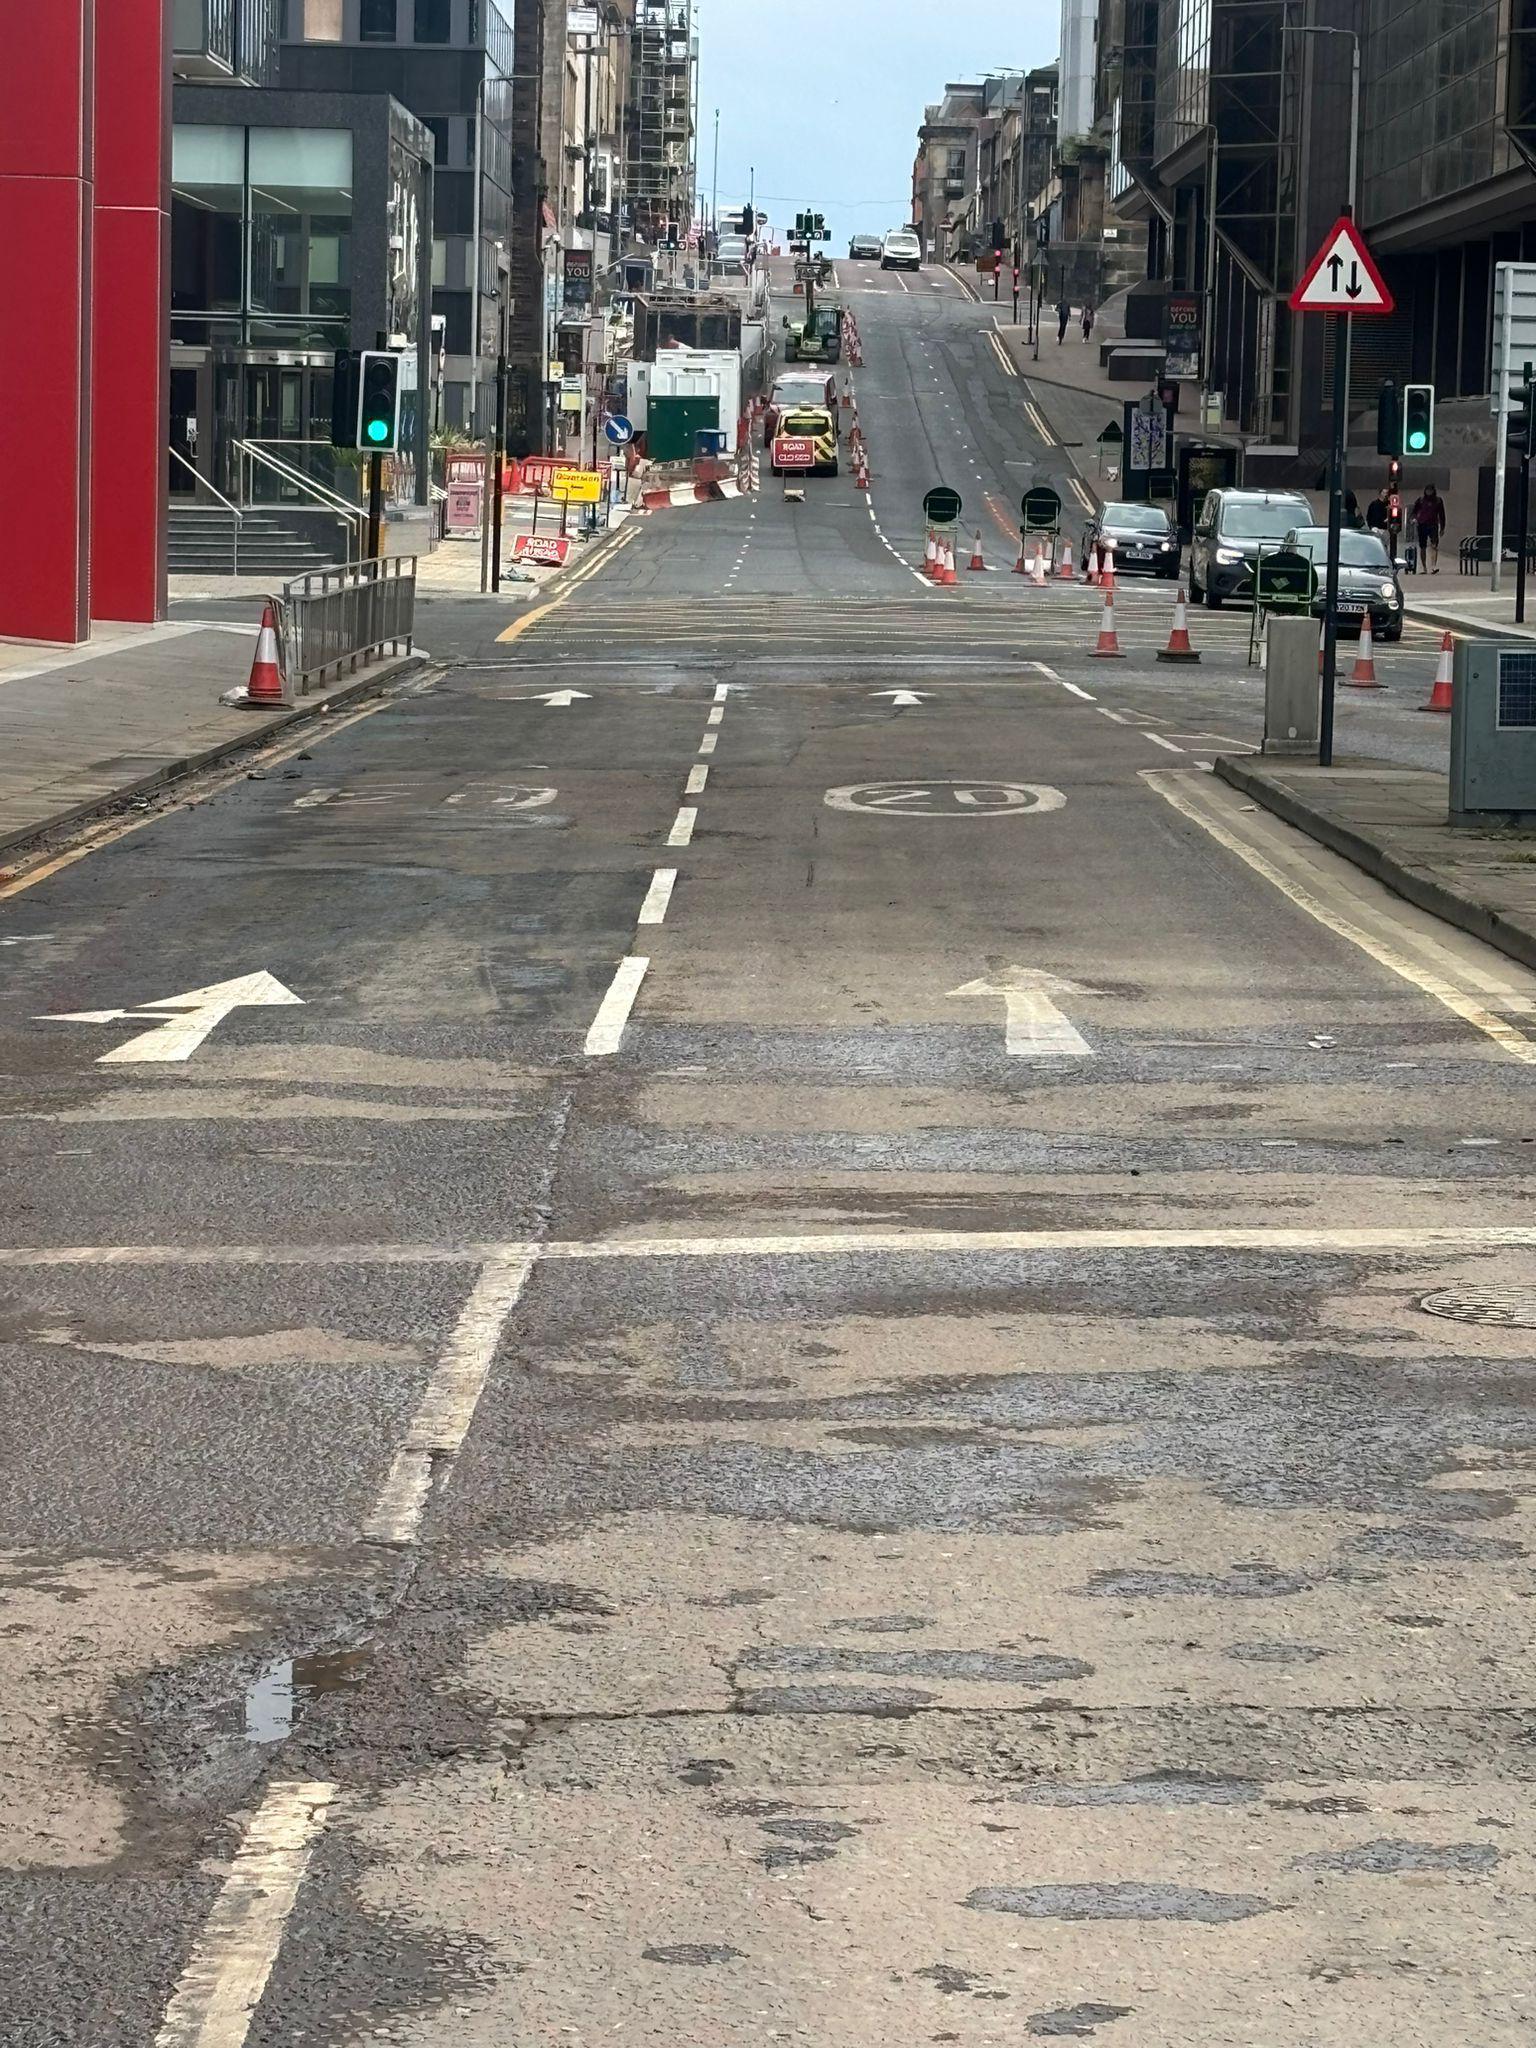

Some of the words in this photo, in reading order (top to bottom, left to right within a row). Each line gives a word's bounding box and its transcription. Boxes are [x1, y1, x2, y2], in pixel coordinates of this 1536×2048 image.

[566, 267, 590, 277] YOU
[1170, 312, 1197, 323] YOU
[782, 443, 806, 451] ROAD
[778, 453, 810, 461] CLOSED
[526, 538, 557, 550] ROAD
[864, 789, 1028, 805] 20
